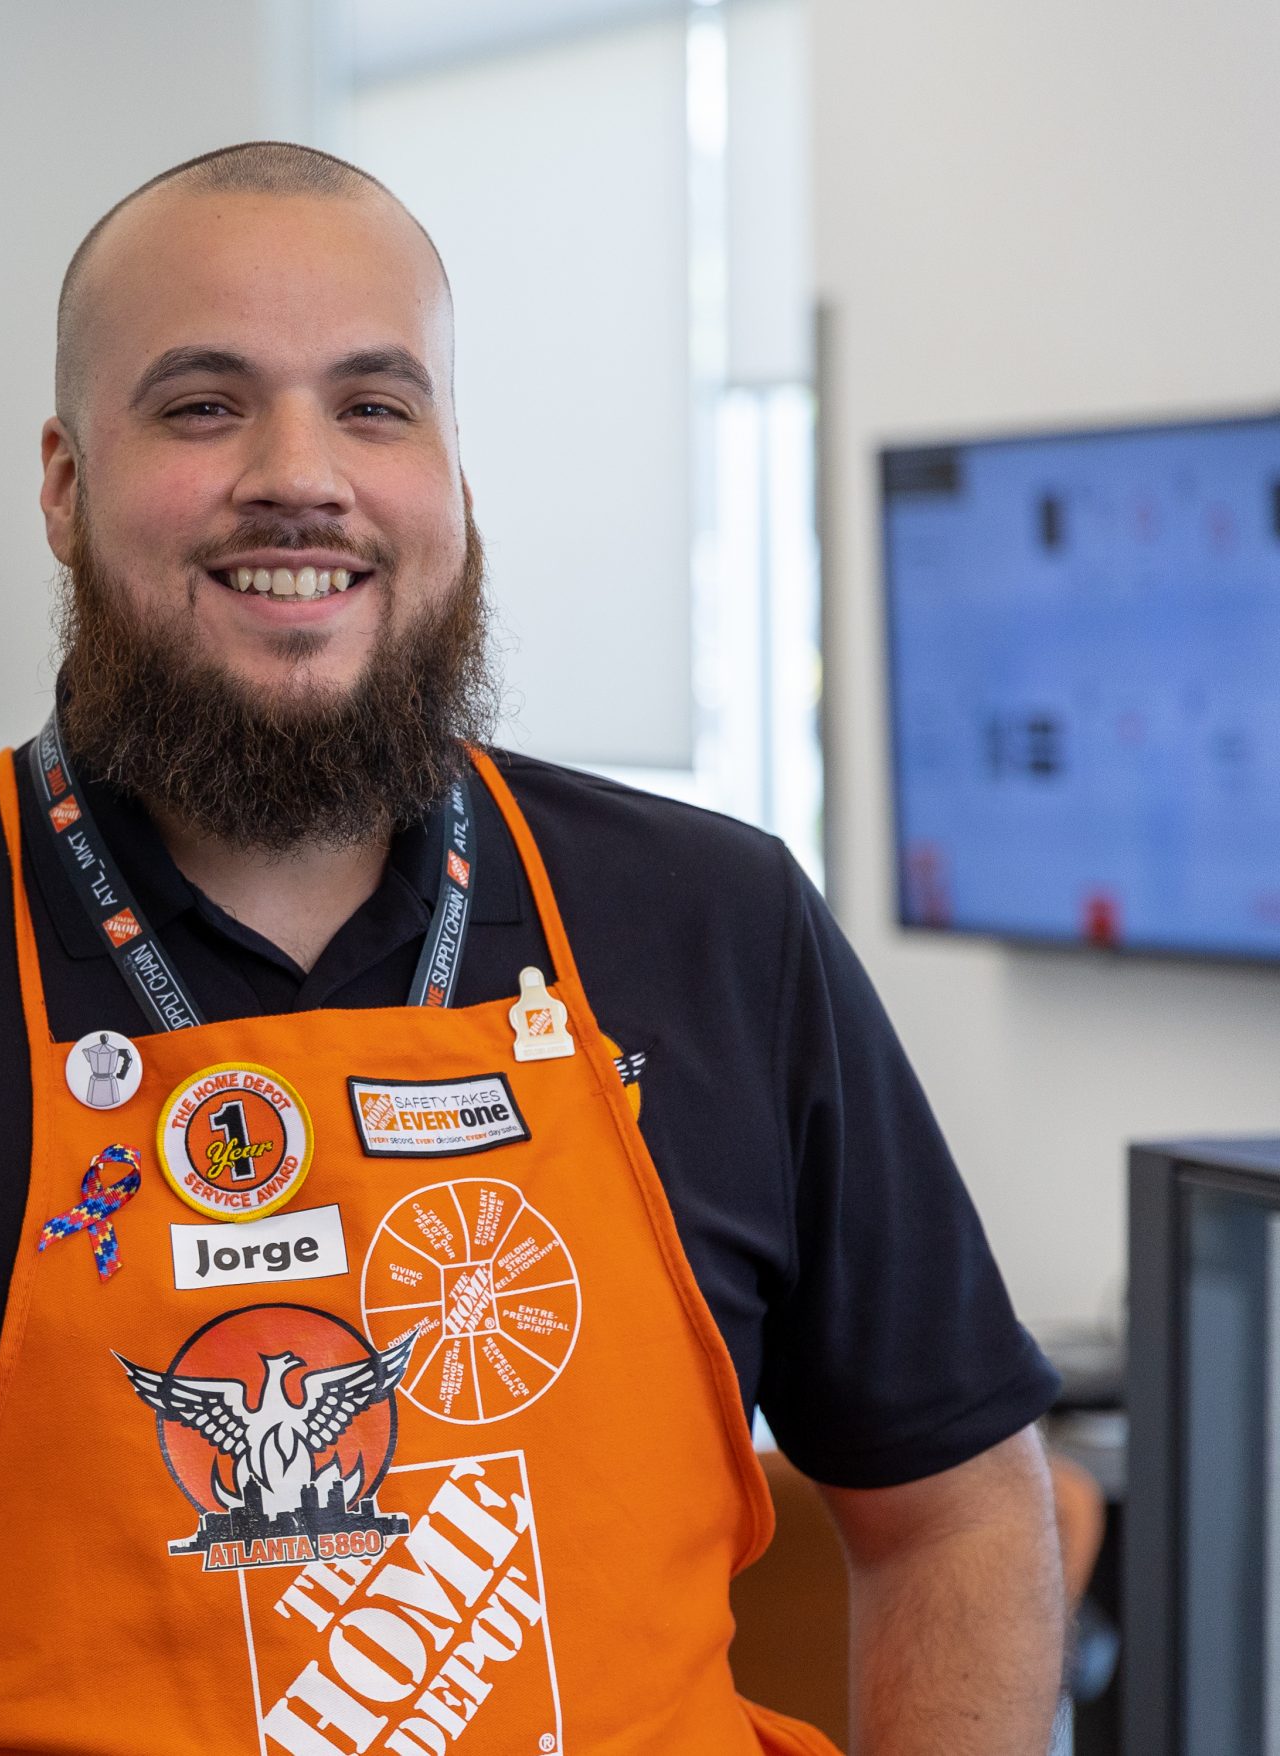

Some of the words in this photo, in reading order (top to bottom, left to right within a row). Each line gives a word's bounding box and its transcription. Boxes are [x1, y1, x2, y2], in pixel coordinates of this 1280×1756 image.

[131, 944, 168, 991] CHAIN
[426, 984, 445, 1008] NE
[445, 888, 465, 936] CHAIN
[155, 991, 195, 1031] UPPLY
[172, 1098, 196, 1130] THE
[193, 1073, 239, 1101] HOME
[243, 1074, 292, 1112] DEPOT
[365, 1094, 391, 1130] HOME
[394, 1096, 448, 1110] SAFETY
[451, 1090, 501, 1106] TAKES
[398, 1103, 510, 1131] EVERYone
[206, 1137, 274, 1179] Year
[209, 1099, 256, 1182] 1
[183, 1171, 252, 1208] SERVICE
[257, 1155, 299, 1205] AWARD
[412, 1203, 432, 1225] CARE
[430, 1226, 442, 1237] OF
[440, 1239, 456, 1259] OUR
[414, 1218, 441, 1250] PEOPLE
[427, 1210, 454, 1241] TAKING
[474, 1188, 488, 1245] EXCELLENT
[481, 1191, 497, 1246] CUSTOMER
[489, 1199, 504, 1243] SERVICE
[195, 1236, 320, 1278] Jorge
[389, 1263, 423, 1280] GIVING
[494, 1239, 560, 1290] RELATIONSHIPS
[497, 1236, 536, 1268] BUILDING
[505, 1244, 539, 1272] STRONG
[391, 1273, 417, 1287] BACK
[445, 1263, 492, 1334] HOME
[449, 1271, 471, 1301] THE
[416, 1319, 440, 1339] HING
[465, 1286, 494, 1332] DEPOT
[502, 1309, 570, 1331] PRENEURIAL
[517, 1322, 554, 1336] SPIRIT
[439, 1350, 452, 1401] CREATING
[443, 1340, 461, 1415] SHAREHOLDER
[454, 1362, 465, 1395] VALUE
[481, 1346, 495, 1363] ALL
[493, 1362, 521, 1398] PEOPLE
[485, 1336, 516, 1376] RESPECT
[514, 1376, 530, 1396] FOR
[208, 1535, 315, 1568] ATLANTA
[319, 1530, 381, 1557] 5860
[263, 1461, 531, 1756] HOME
[383, 1566, 542, 1756] DEPOT
